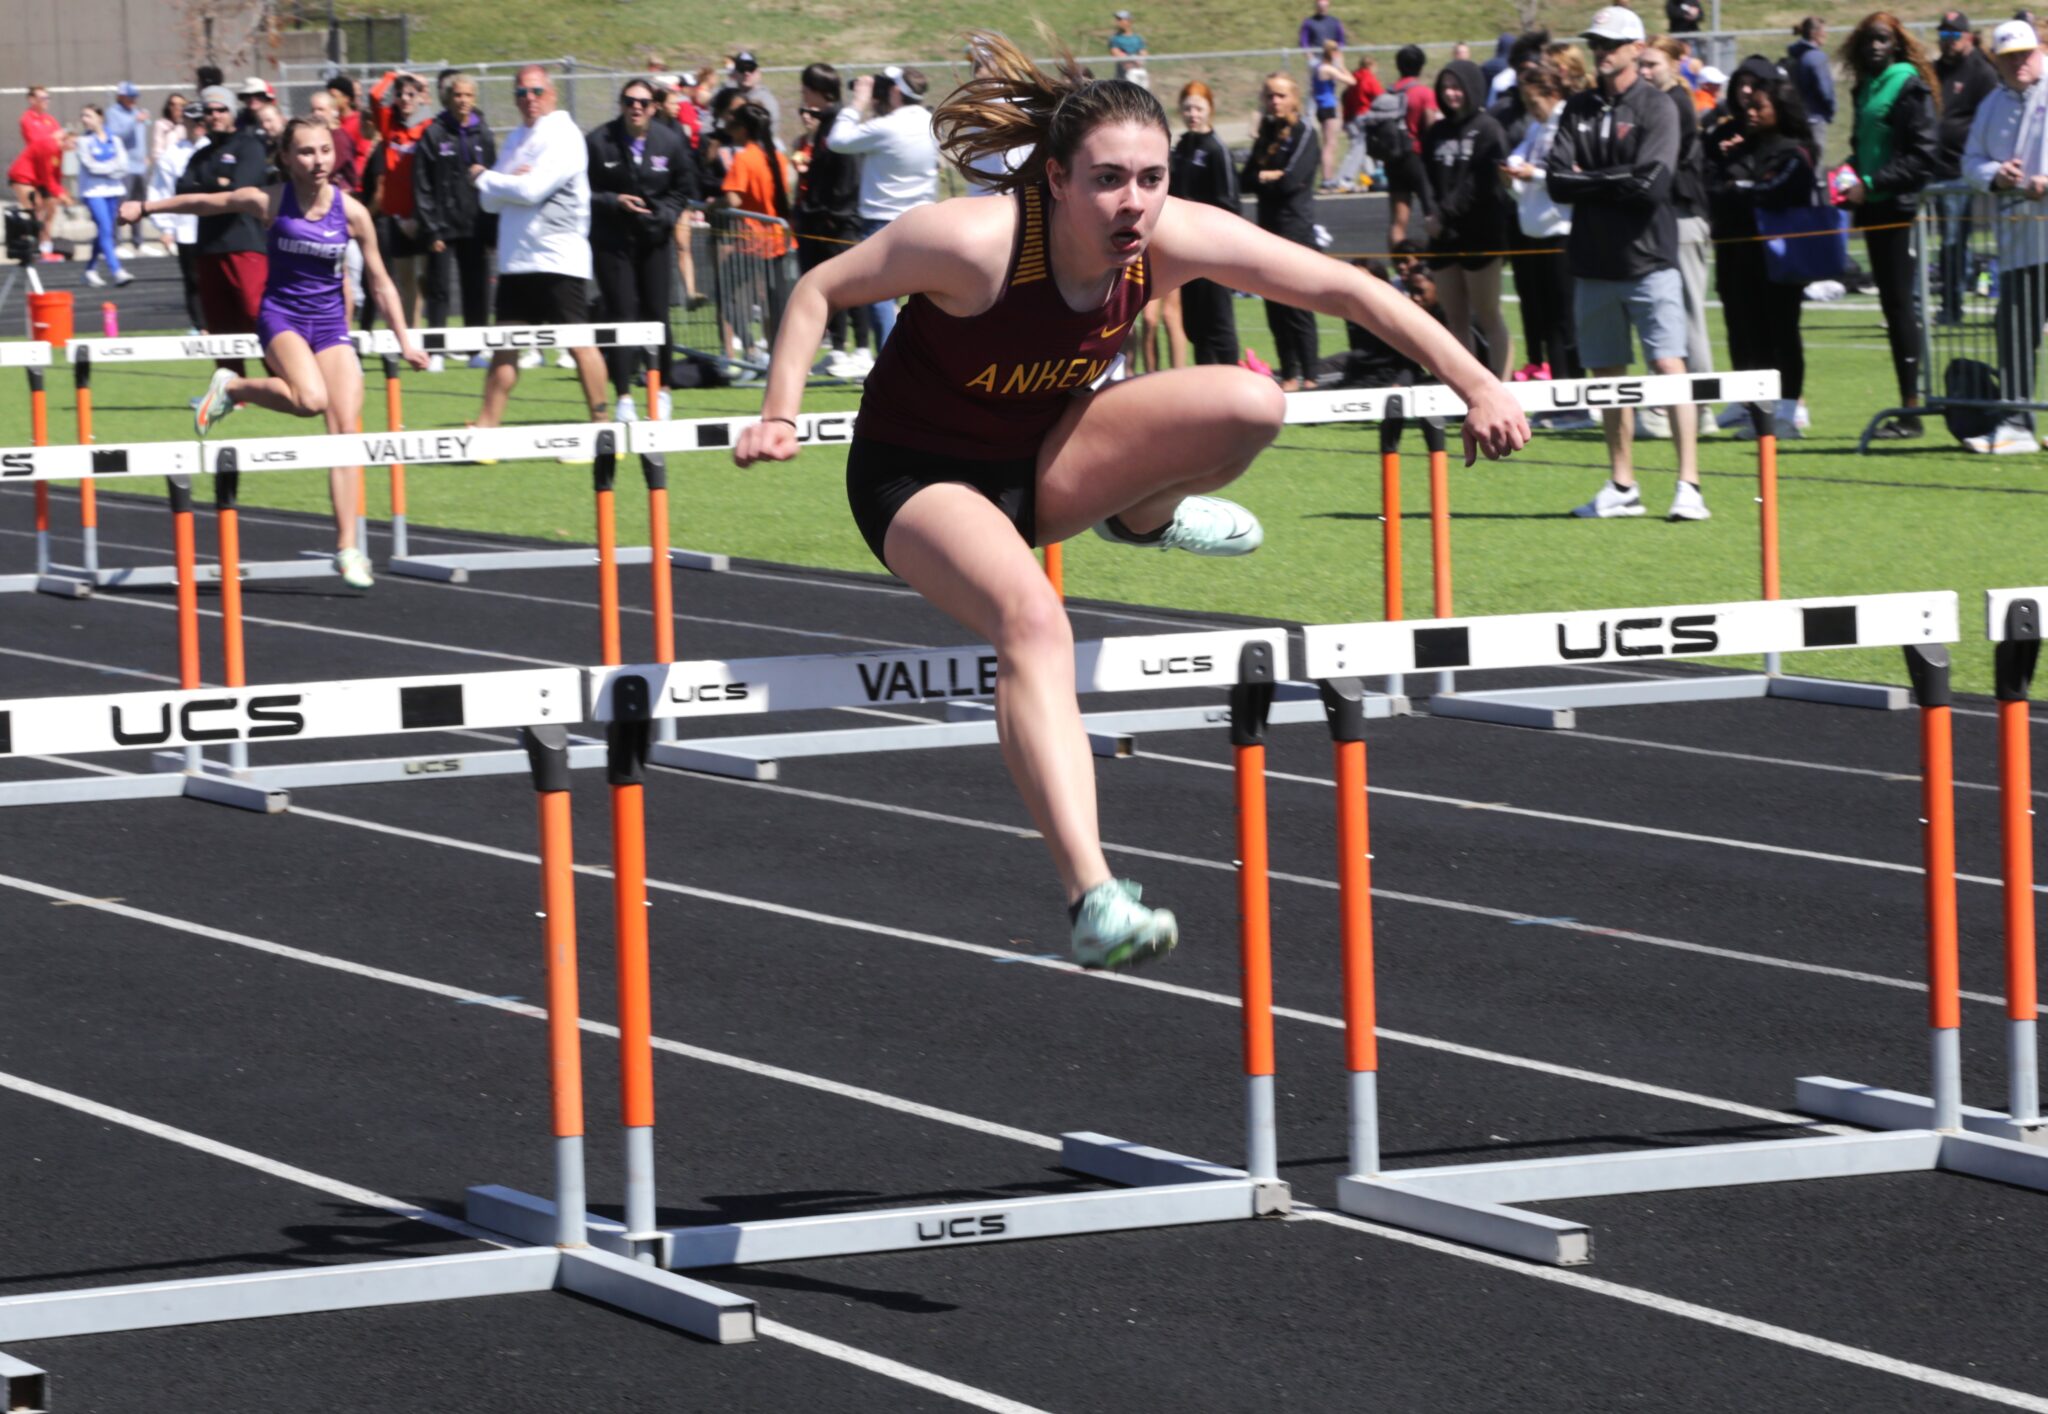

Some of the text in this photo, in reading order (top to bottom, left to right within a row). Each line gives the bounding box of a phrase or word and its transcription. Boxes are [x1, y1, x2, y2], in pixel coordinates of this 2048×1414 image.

[180, 339, 259, 357] VALLEY
[484, 330, 556, 347] UCS
[966, 358, 1112, 394] ANKEN
[1331, 402, 1372, 413] UCS
[1551, 382, 1643, 407] UCS
[250, 436, 580, 463] UCS VALLEY UCS
[1556, 614, 1719, 660] UCS
[670, 655, 1213, 703] UCS VALLE UCS
[111, 694, 304, 746] UCS
[404, 760, 460, 774] UCS
[917, 1214, 1006, 1241] UCS
